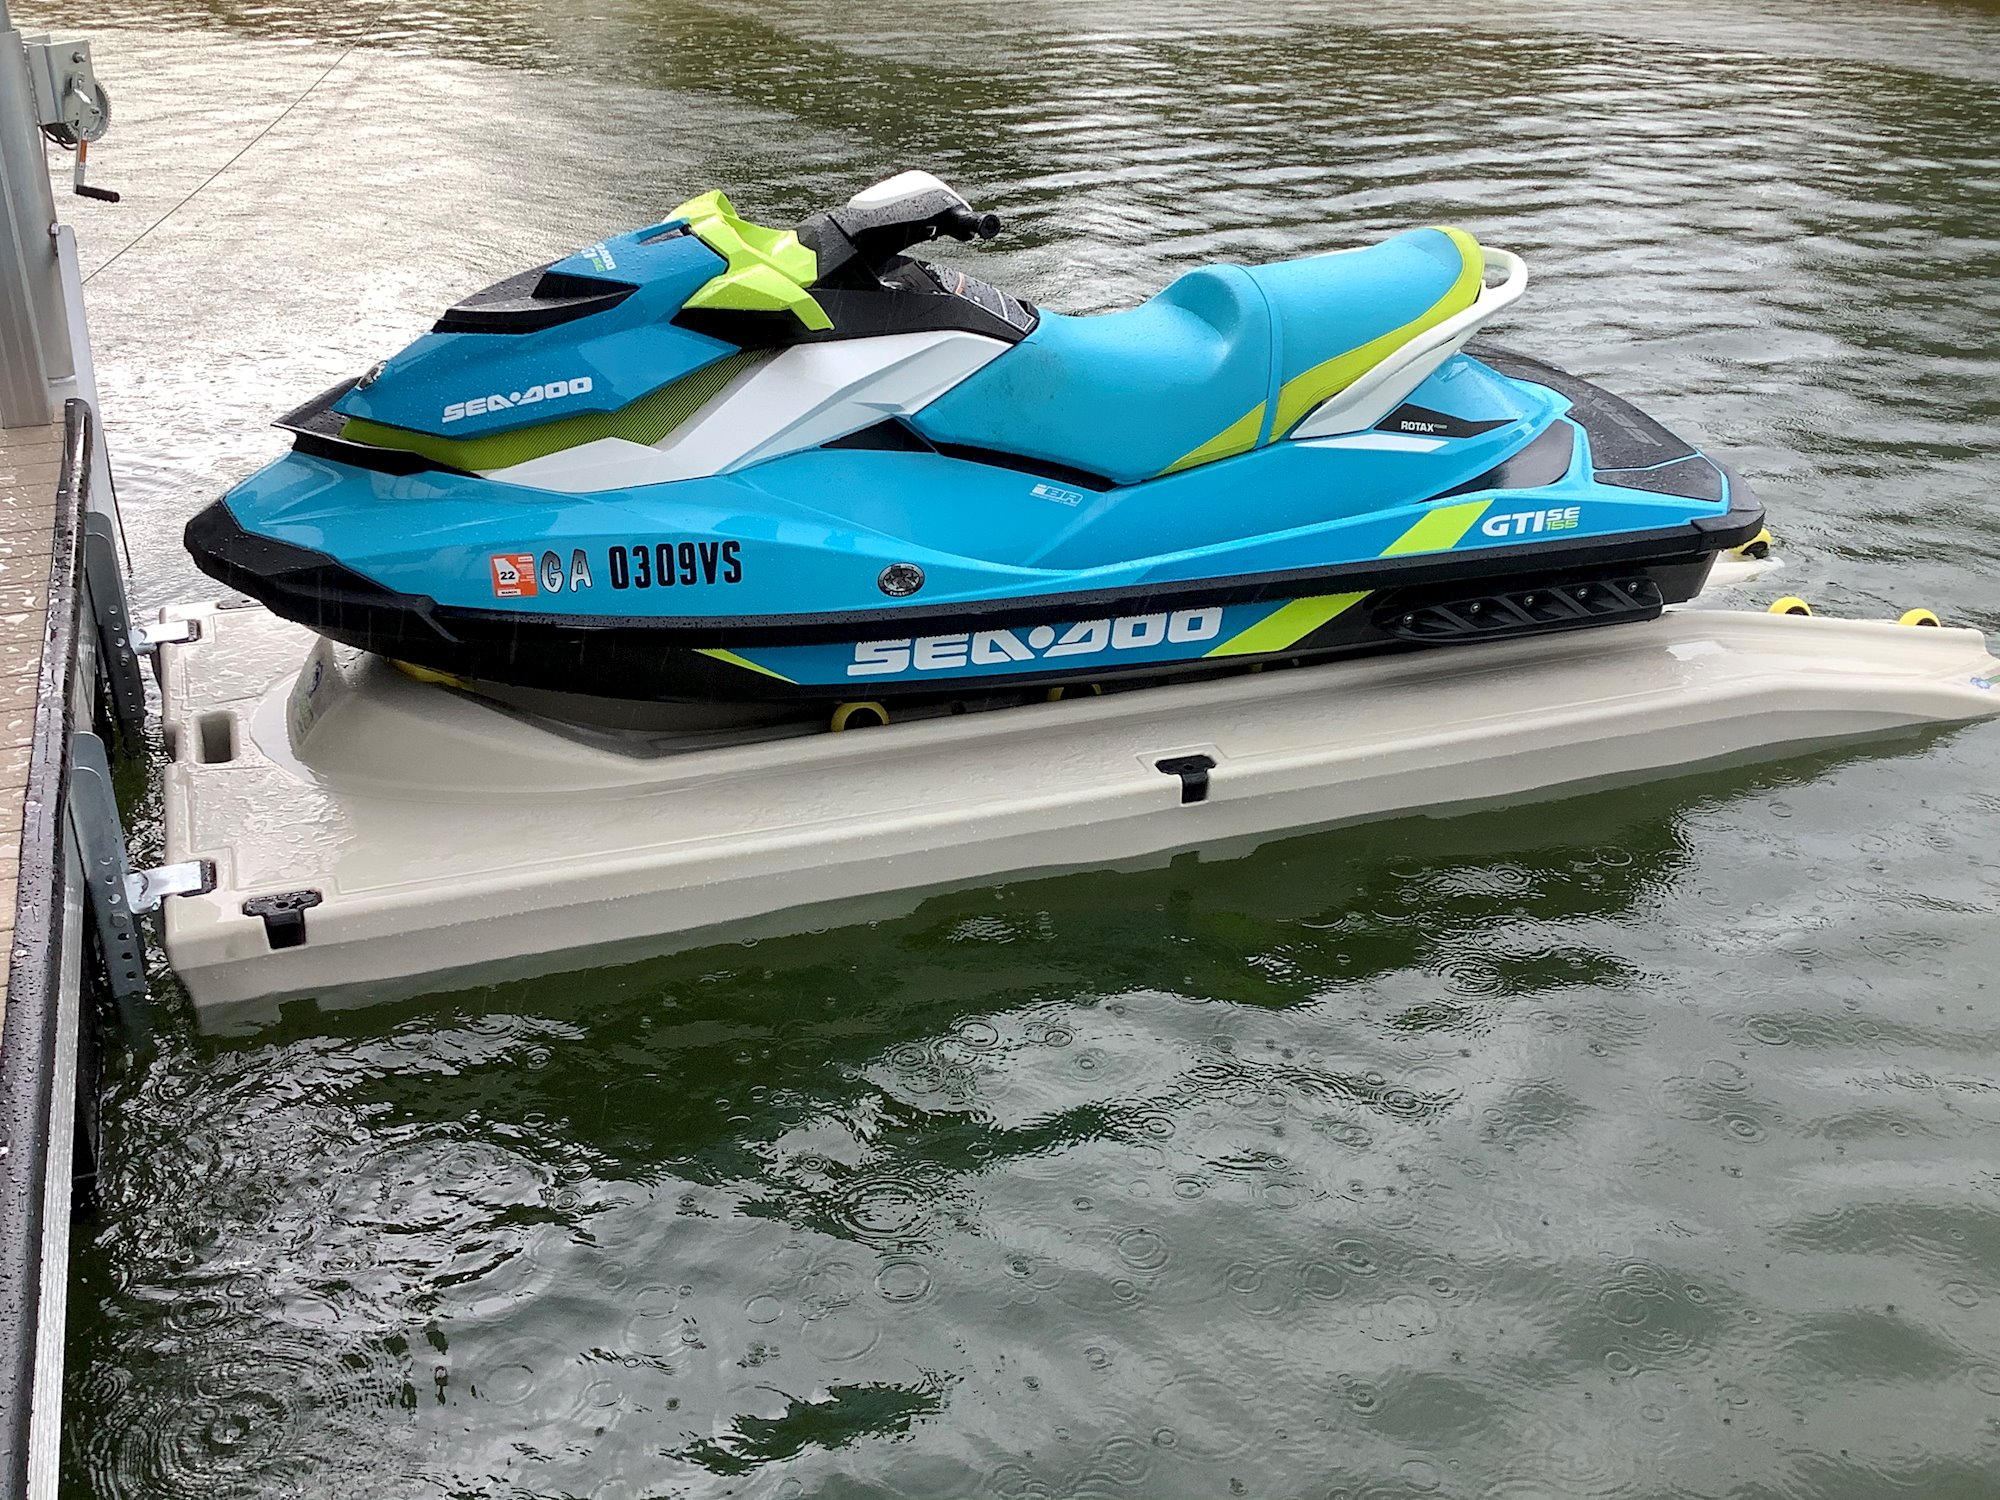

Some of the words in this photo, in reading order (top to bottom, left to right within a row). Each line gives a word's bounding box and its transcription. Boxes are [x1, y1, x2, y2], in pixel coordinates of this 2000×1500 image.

[1400, 420, 1435, 433] ROTAX
[1481, 510, 1546, 537] GTI
[1546, 506, 1582, 521] SE
[1545, 518, 1579, 531] 155
[540, 548, 593, 594] GA
[607, 539, 743, 591] 0309VS
[499, 570, 516, 581] 22
